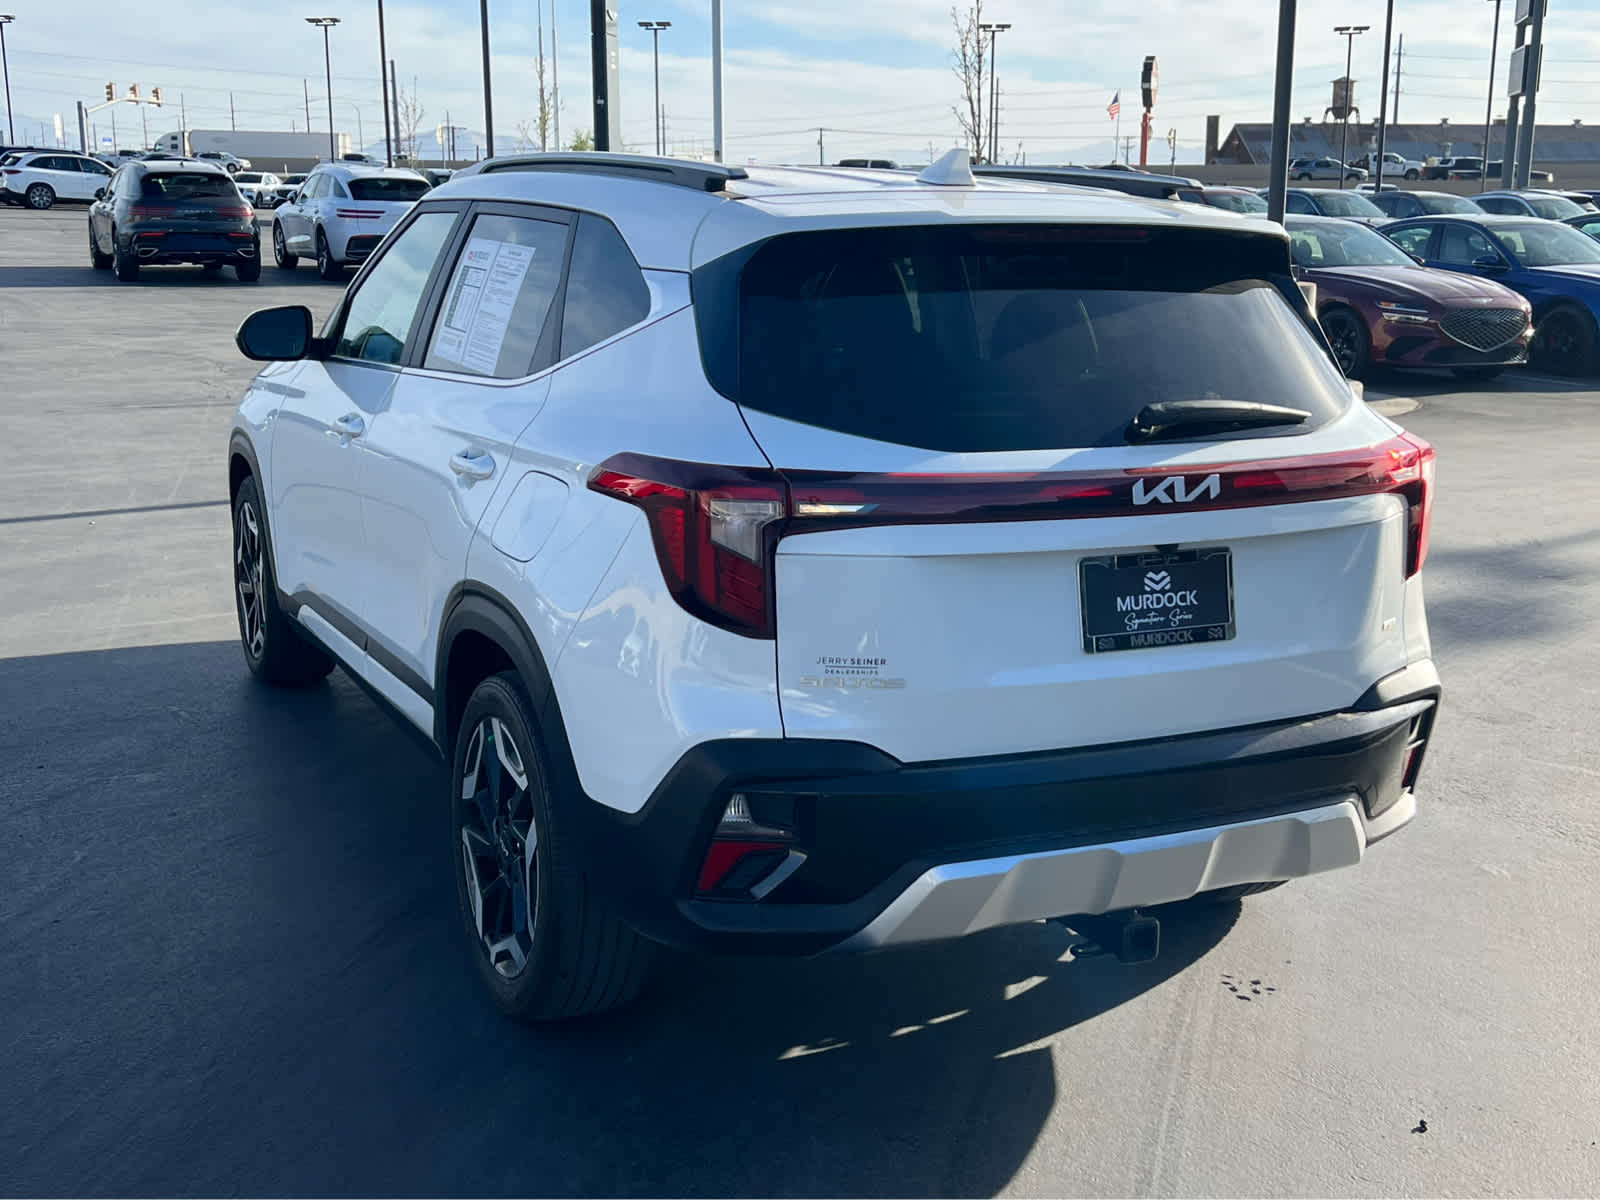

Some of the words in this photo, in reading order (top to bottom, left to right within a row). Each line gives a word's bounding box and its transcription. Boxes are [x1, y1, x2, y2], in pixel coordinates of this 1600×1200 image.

[1132, 473, 1221, 506] KIA
[1117, 590, 1199, 612] MURDOCK
[1125, 612, 1165, 631] Signature
[1169, 608, 1193, 626] Series
[1130, 629, 1194, 648] MURDOCK
[816, 656, 848, 665] JERRY
[850, 657, 887, 666] SEINER
[824, 668, 879, 676] DEALERSHIPS
